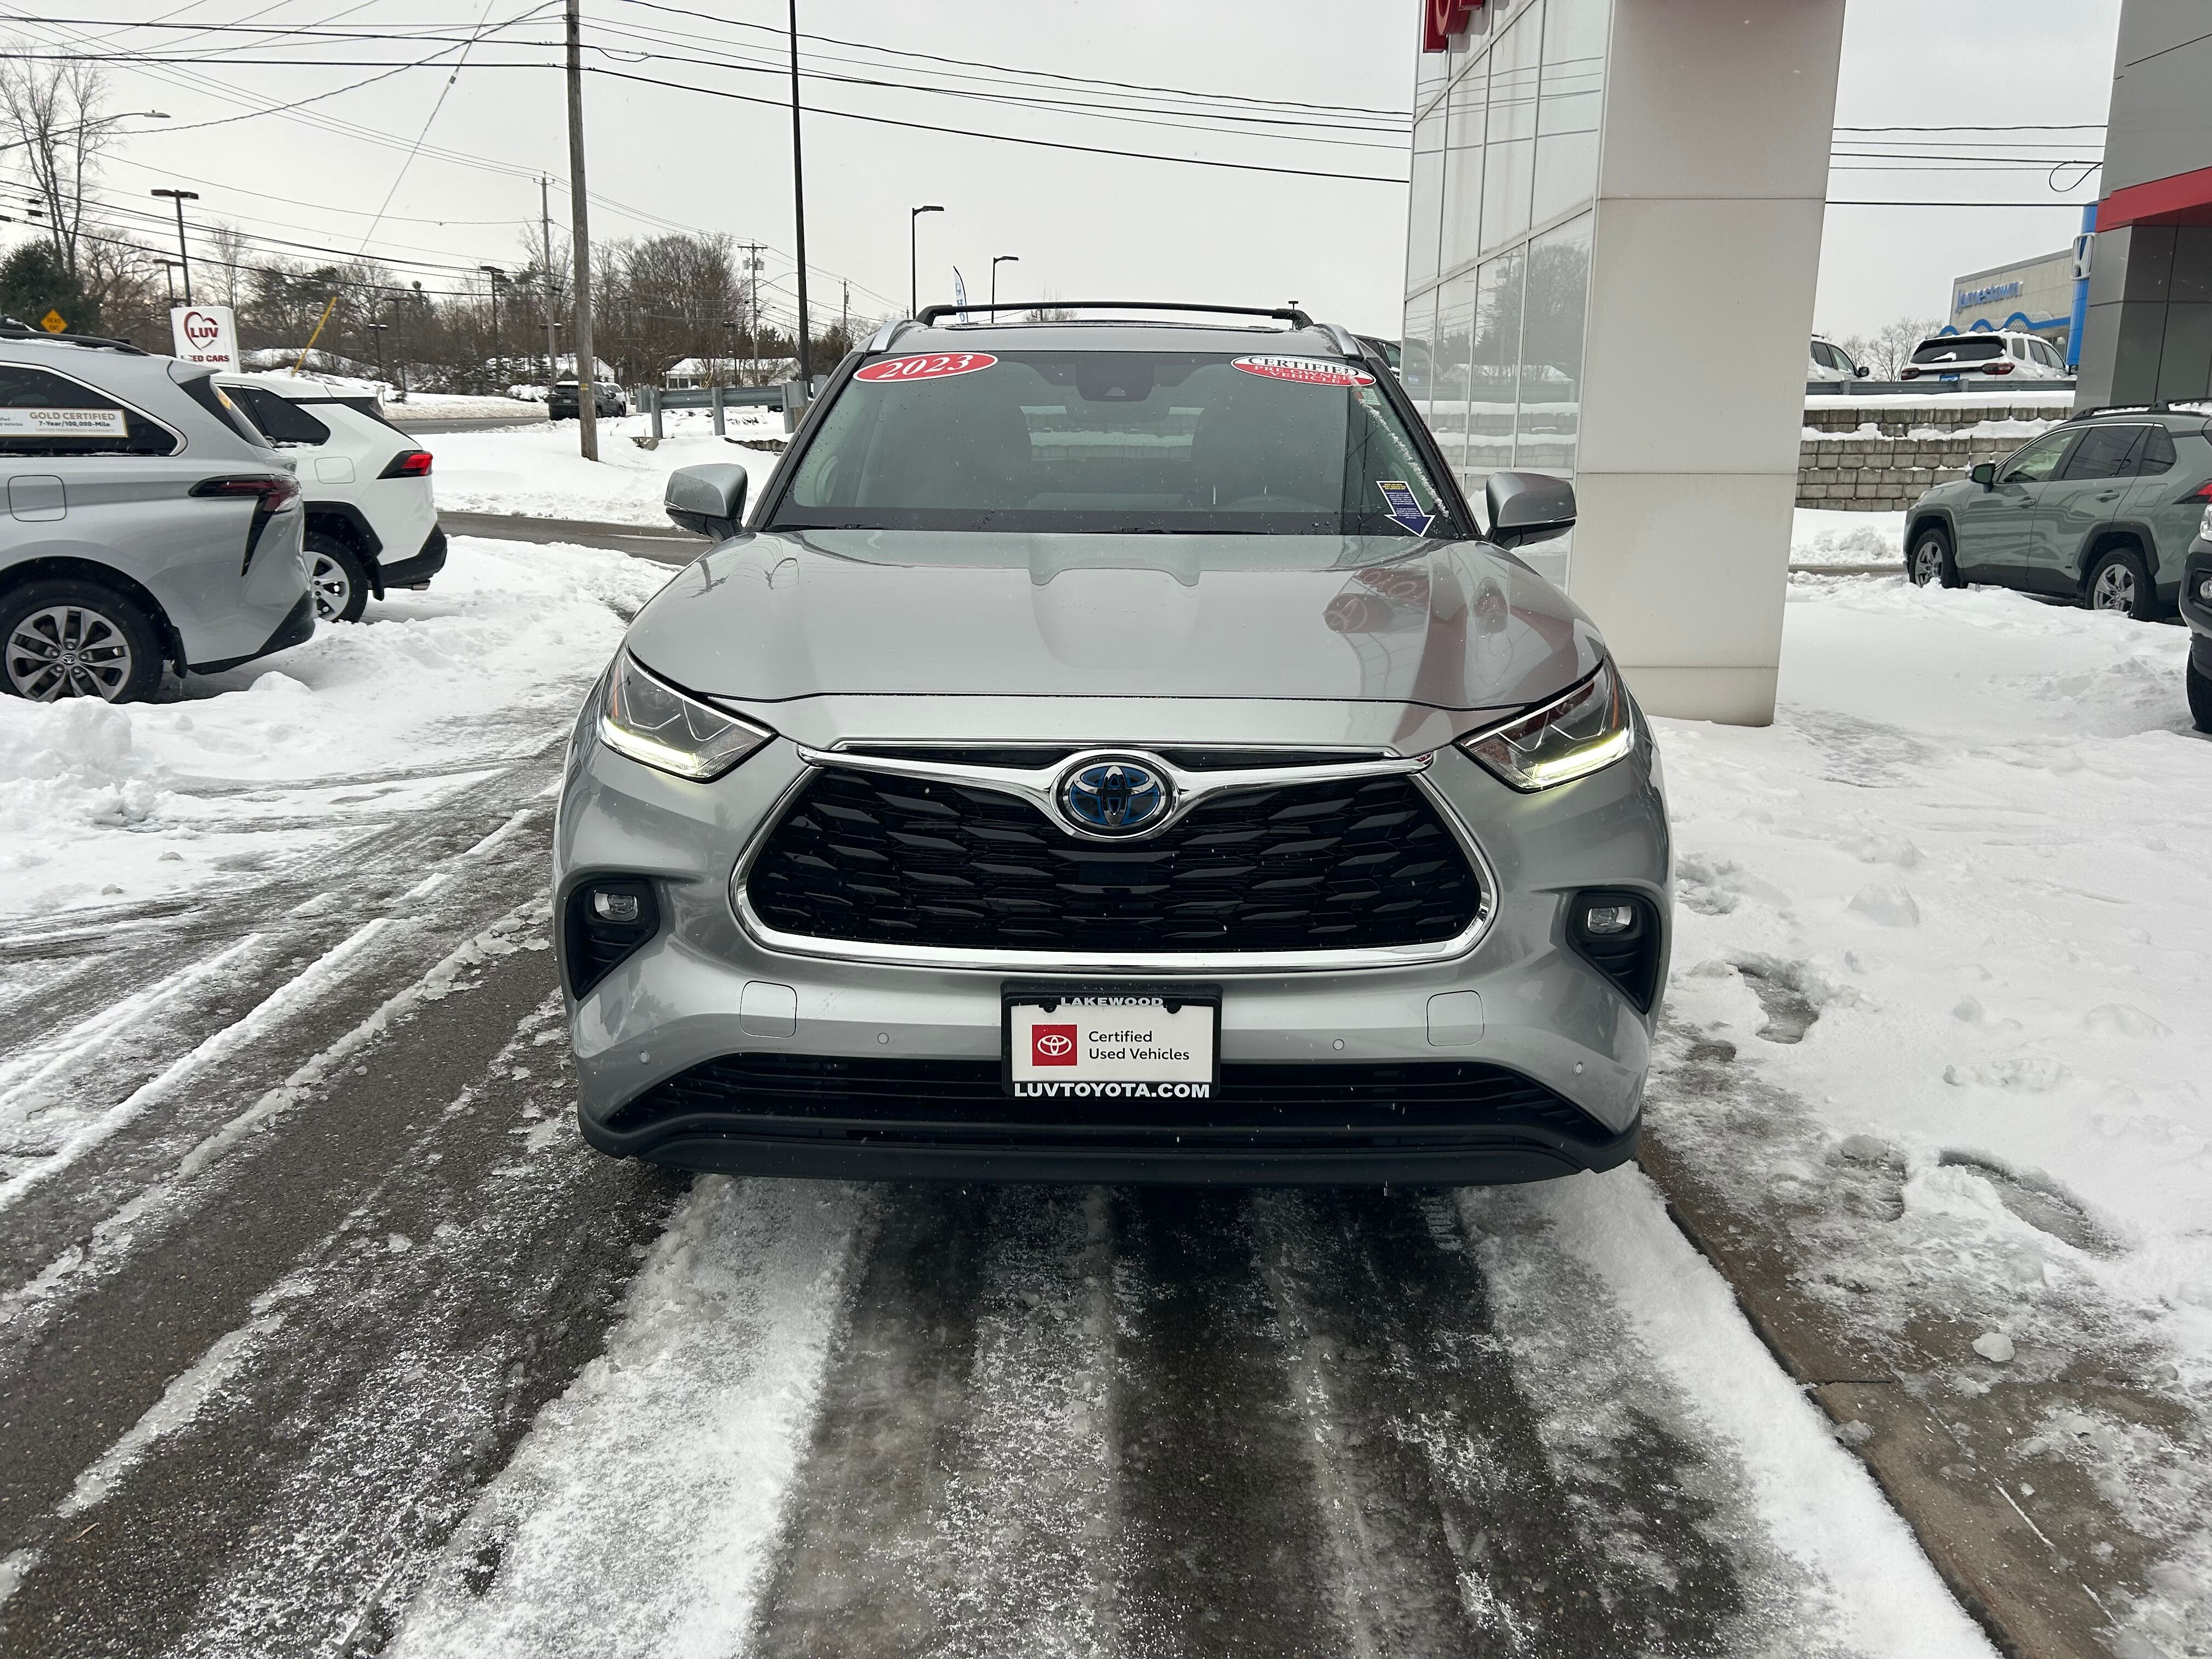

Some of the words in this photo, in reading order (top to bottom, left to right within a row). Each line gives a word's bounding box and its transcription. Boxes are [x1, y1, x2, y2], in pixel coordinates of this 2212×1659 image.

[1955, 282, 2021, 314] Jamestown
[190, 327, 219, 338] LUV
[876, 355, 974, 379] 2023
[1248, 358, 1359, 376] CERTIFIED
[1268, 371, 1340, 383] VEHICLE
[1060, 997, 1164, 1006] LAKEWOOD
[1088, 1030, 1153, 1042] Certified
[1089, 1048, 1125, 1059] Used
[1130, 1048, 1190, 1060] Vehicles
[1014, 1082, 1210, 1098] LUVTOYOTA.COM
